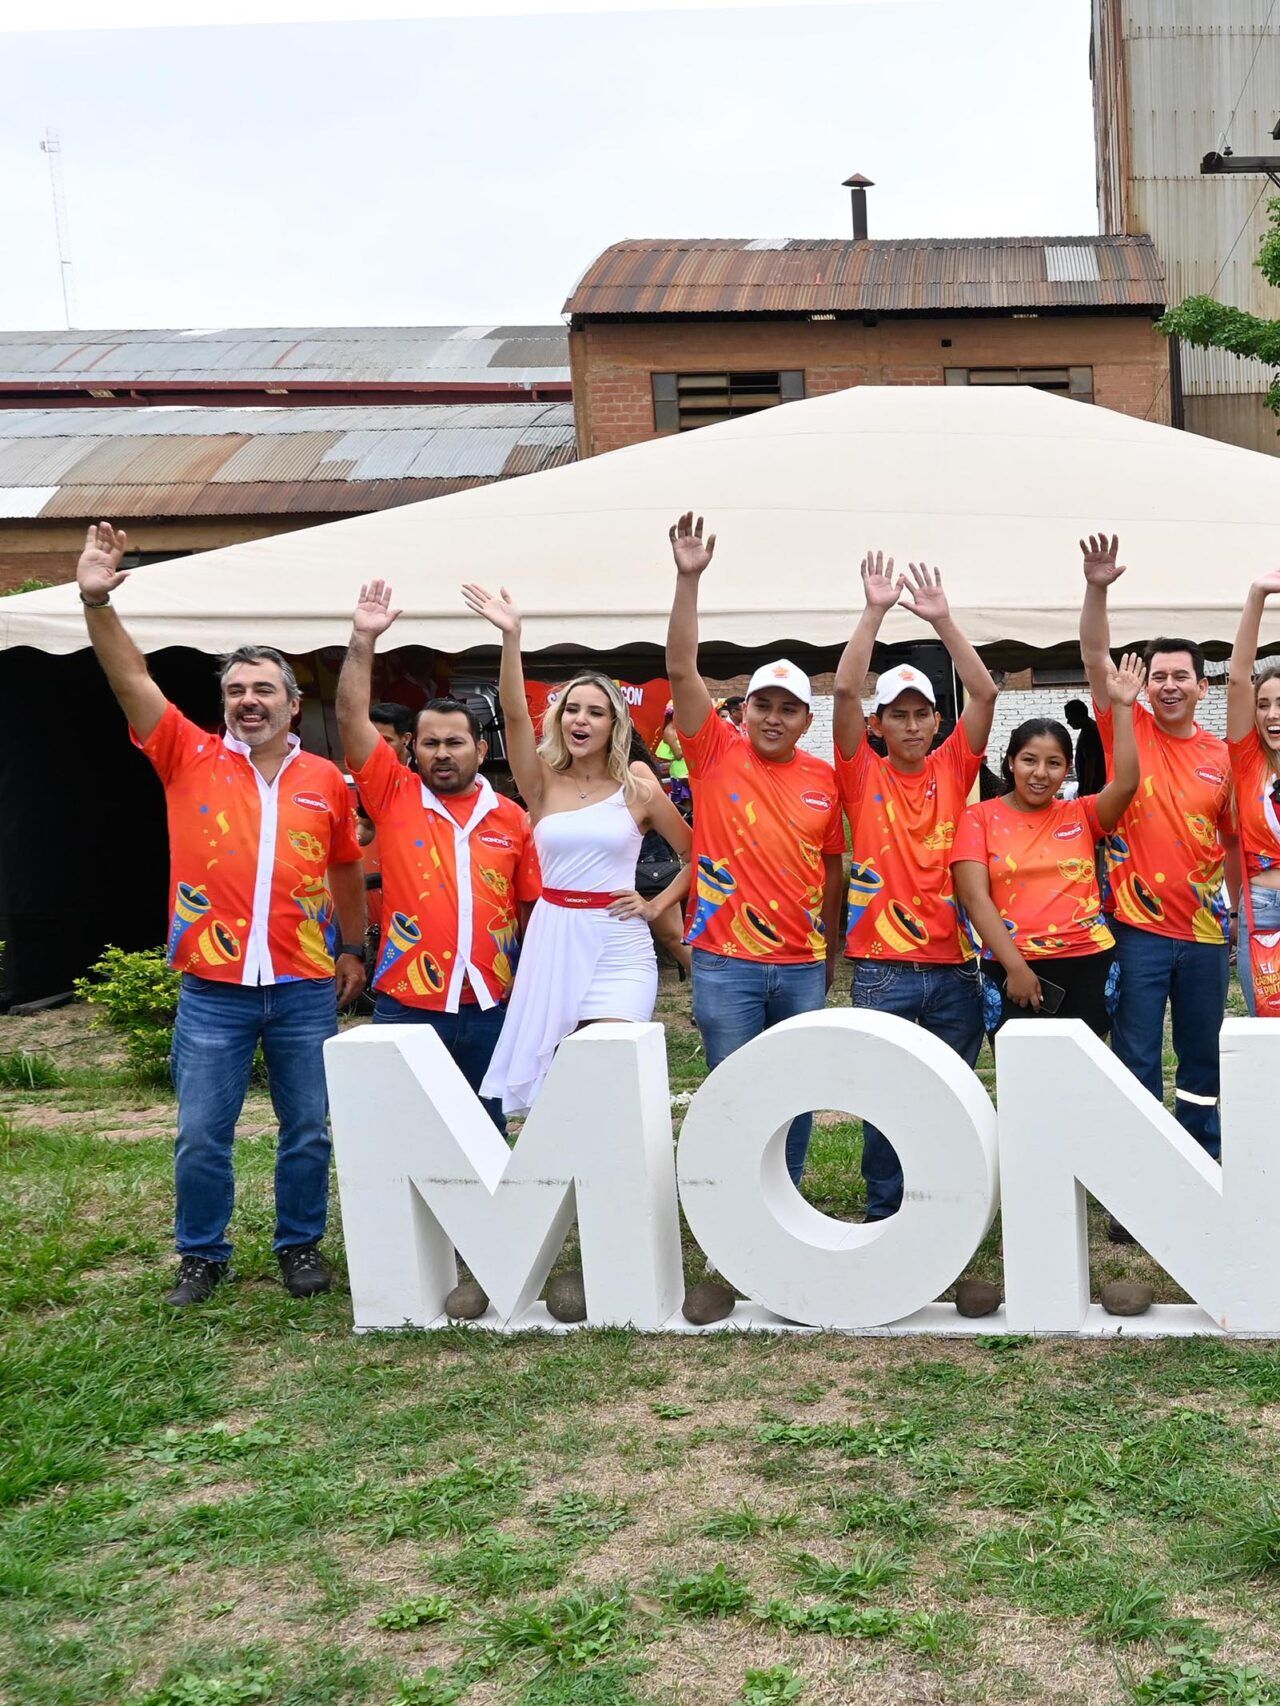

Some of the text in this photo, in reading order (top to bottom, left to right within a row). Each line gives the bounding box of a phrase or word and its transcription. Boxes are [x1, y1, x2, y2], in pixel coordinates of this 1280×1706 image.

[297, 797, 329, 809] MONOPOL
[1057, 827, 1082, 838] MONOPOL
[481, 836, 510, 847] MONOPOL
[1260, 961, 1276, 974] EL
